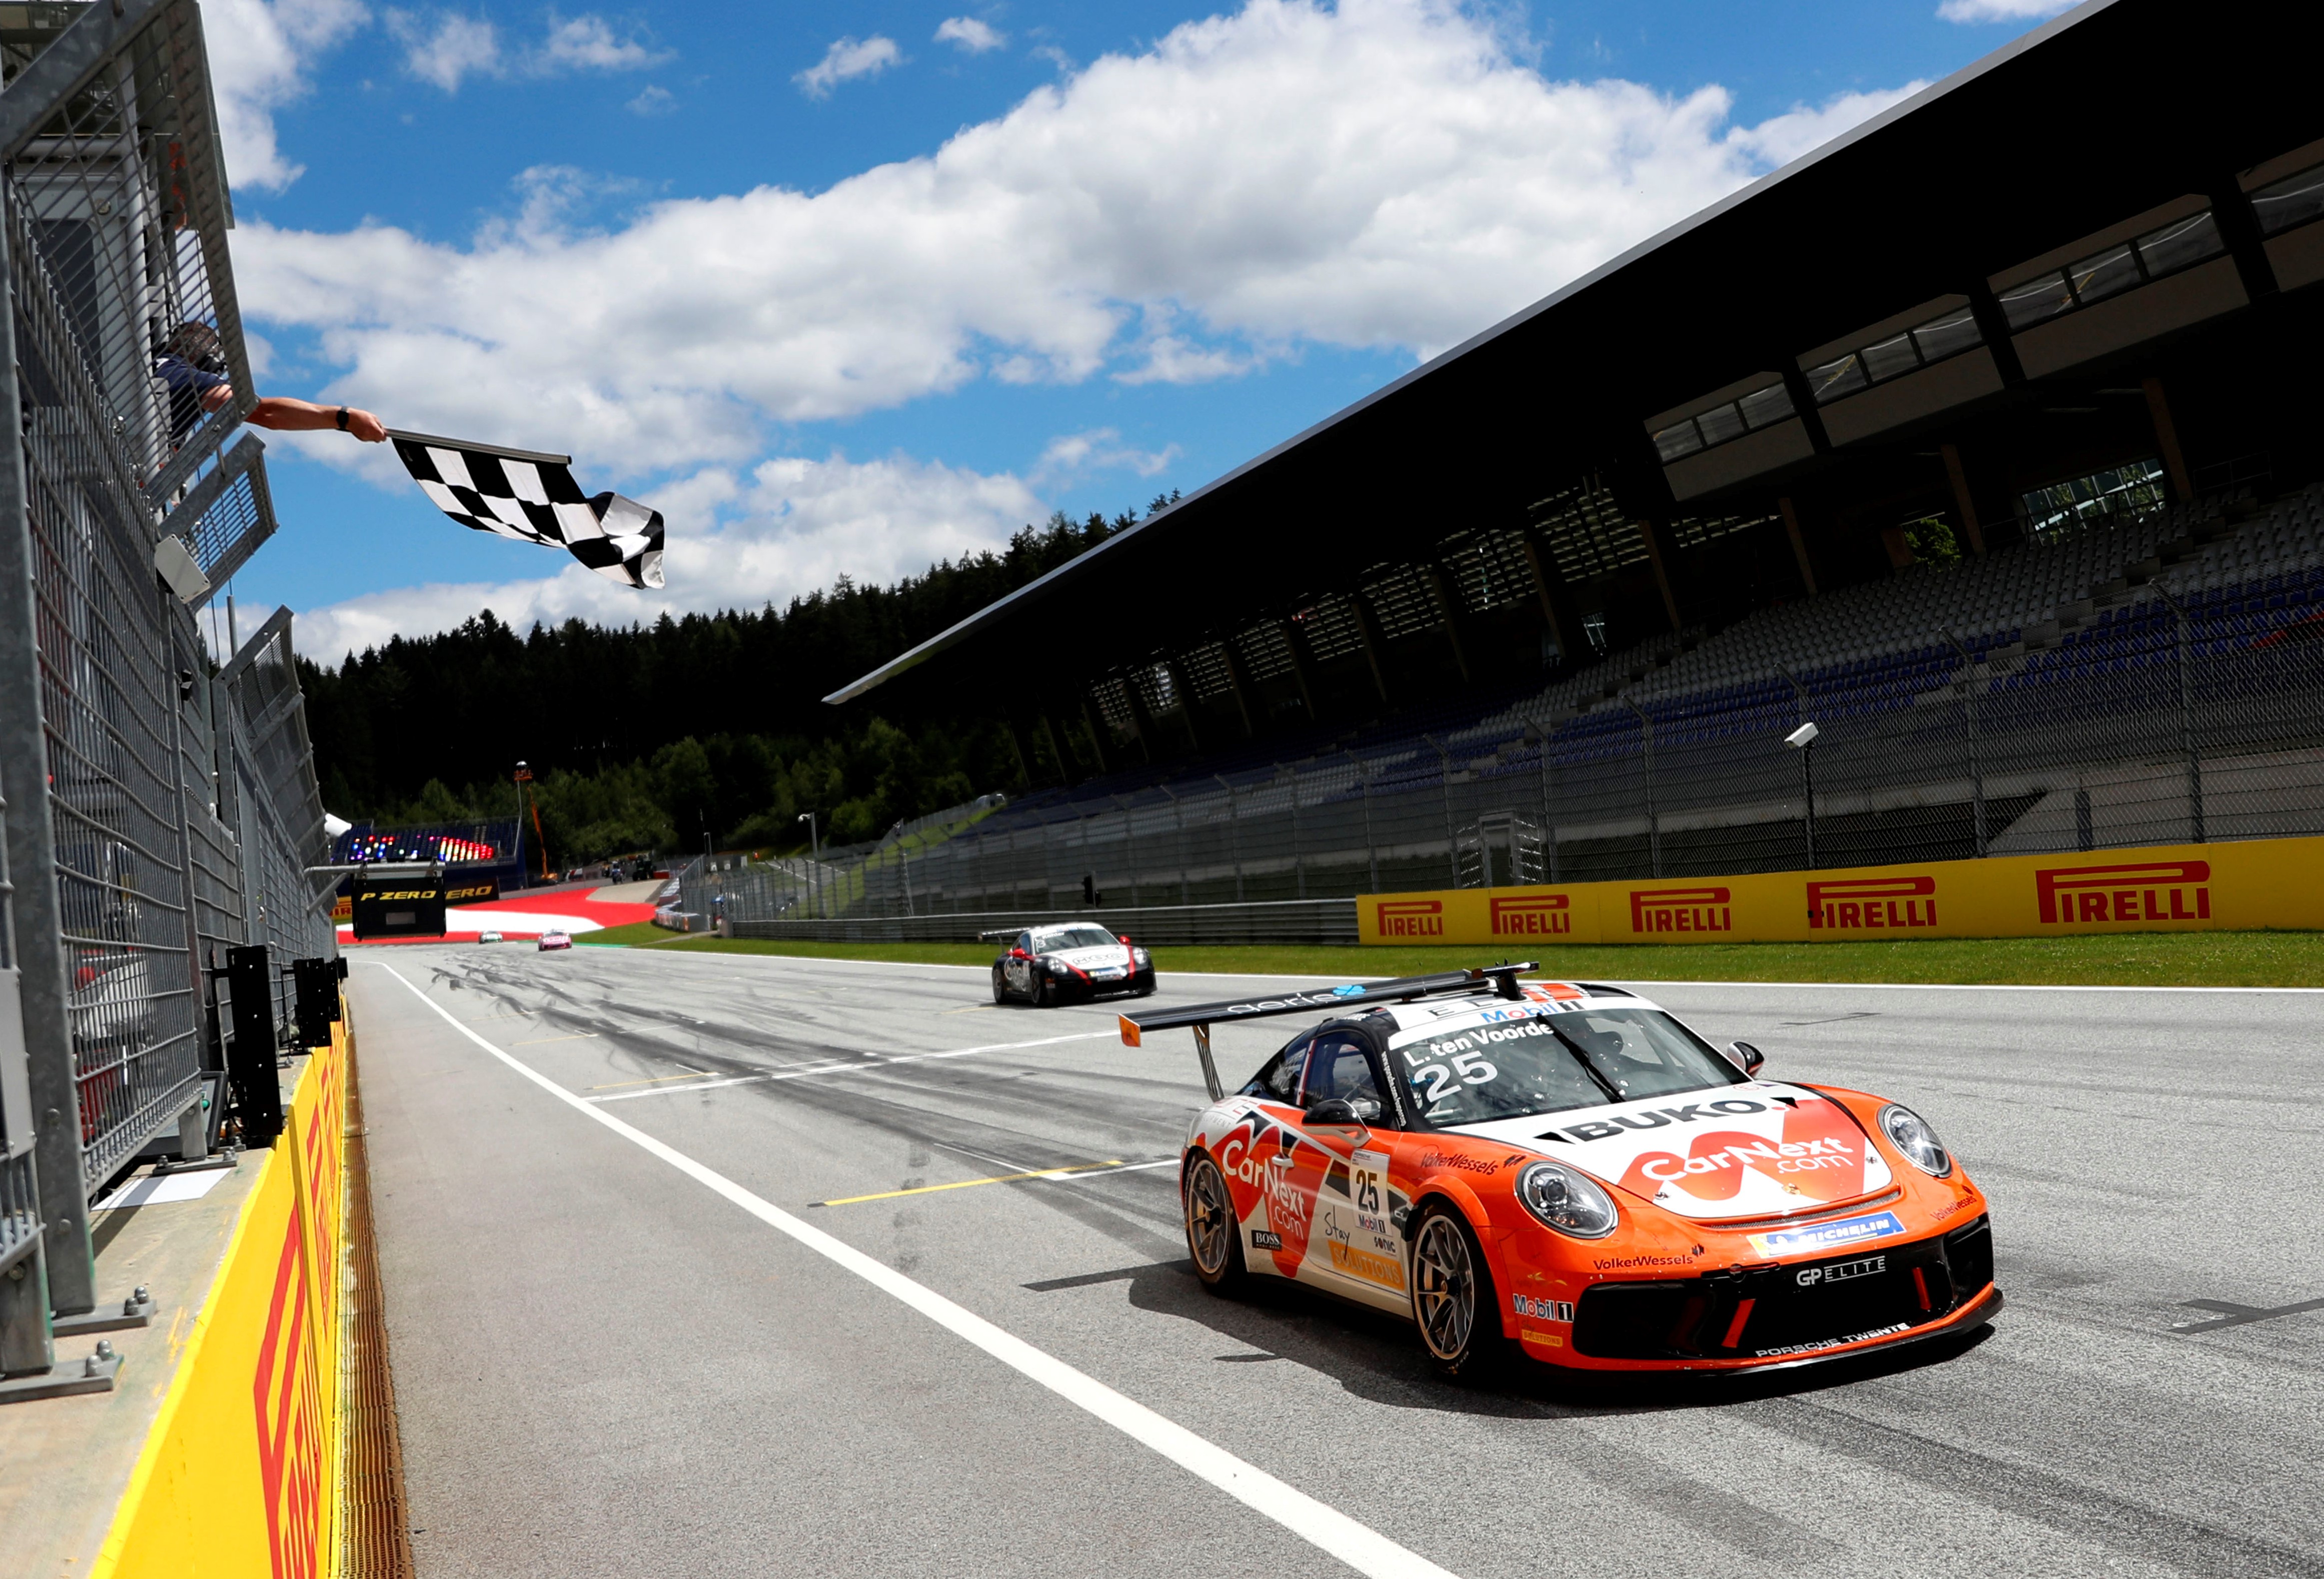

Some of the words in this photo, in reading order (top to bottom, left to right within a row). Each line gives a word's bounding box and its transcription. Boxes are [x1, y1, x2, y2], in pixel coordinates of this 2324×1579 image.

[361, 891, 376, 901] P
[379, 890, 437, 900] ZERO
[445, 886, 492, 900] ERO
[1806, 876, 1937, 928] PIRELLI
[2035, 860, 2210, 923] PIRELLI
[1377, 900, 1443, 936] PIRELLI
[1490, 894, 1570, 934] PIRELLI
[1630, 887, 1731, 932] PIRELLI
[1480, 1002, 1558, 1023] Mobil
[1403, 1051, 1431, 1067] L.
[1430, 1036, 1473, 1056] ten
[1469, 1021, 1554, 1045] Voorde
[1414, 1050, 1498, 1103] 25
[1421, 1152, 1498, 1175] VolkerWessels
[1641, 1137, 1854, 1181] CarNext
[1778, 1155, 1854, 1174] .com
[1222, 1139, 1307, 1222] CarNext
[1356, 1168, 1380, 1215] 25
[1255, 1232, 1281, 1245] BOSS
[1274, 1206, 1304, 1240] .com
[1324, 1205, 1351, 1260] Stay
[1358, 1214, 1378, 1232] Mobil
[1798, 1219, 1890, 1243] MICHELIN
[1333, 1247, 1401, 1284] SOLUTIONS
[1593, 1254, 1693, 1270] VolkerWessels
[1796, 1268, 1822, 1286] GP
[1824, 1258, 1886, 1280] ELITE
[1513, 1293, 1556, 1321] Mobil
[1755, 1338, 1841, 1357] PORSCHE
[1842, 1322, 1911, 1342] TWENTE
[254, 1197, 322, 1579] PRELLI
